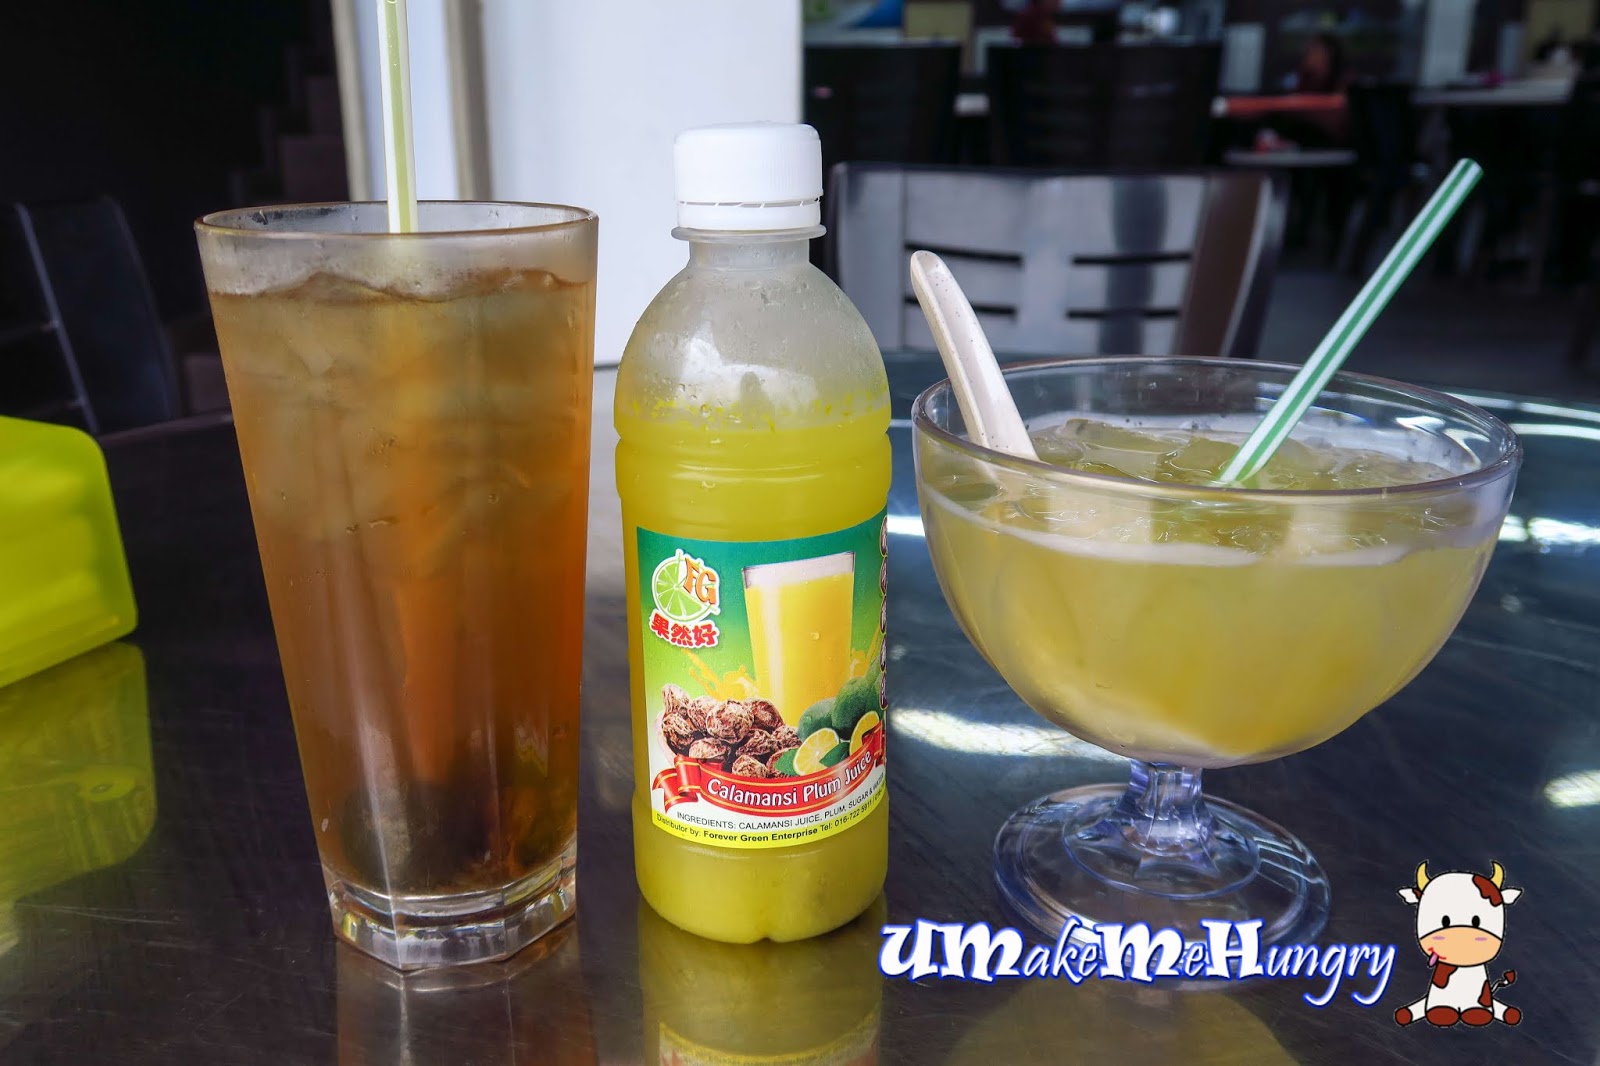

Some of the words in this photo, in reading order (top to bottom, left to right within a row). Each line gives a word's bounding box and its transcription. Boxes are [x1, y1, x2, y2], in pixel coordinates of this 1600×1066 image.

[683, 557, 717, 605] FG
[650, 612, 717, 647] 果然好
[706, 778, 798, 807] Calamansi
[803, 776, 842, 803] Plum
[844, 750, 873, 785] Juice
[656, 813, 688, 832] Distributor
[703, 830, 737, 841] Forever
[740, 834, 769, 842] Green
[771, 828, 818, 842] Enterprise
[820, 821, 833, 832] Tel:
[676, 811, 737, 829] INGREDIENTS:
[738, 819, 793, 830] CALAMANSI
[848, 790, 869, 809] SUGAR
